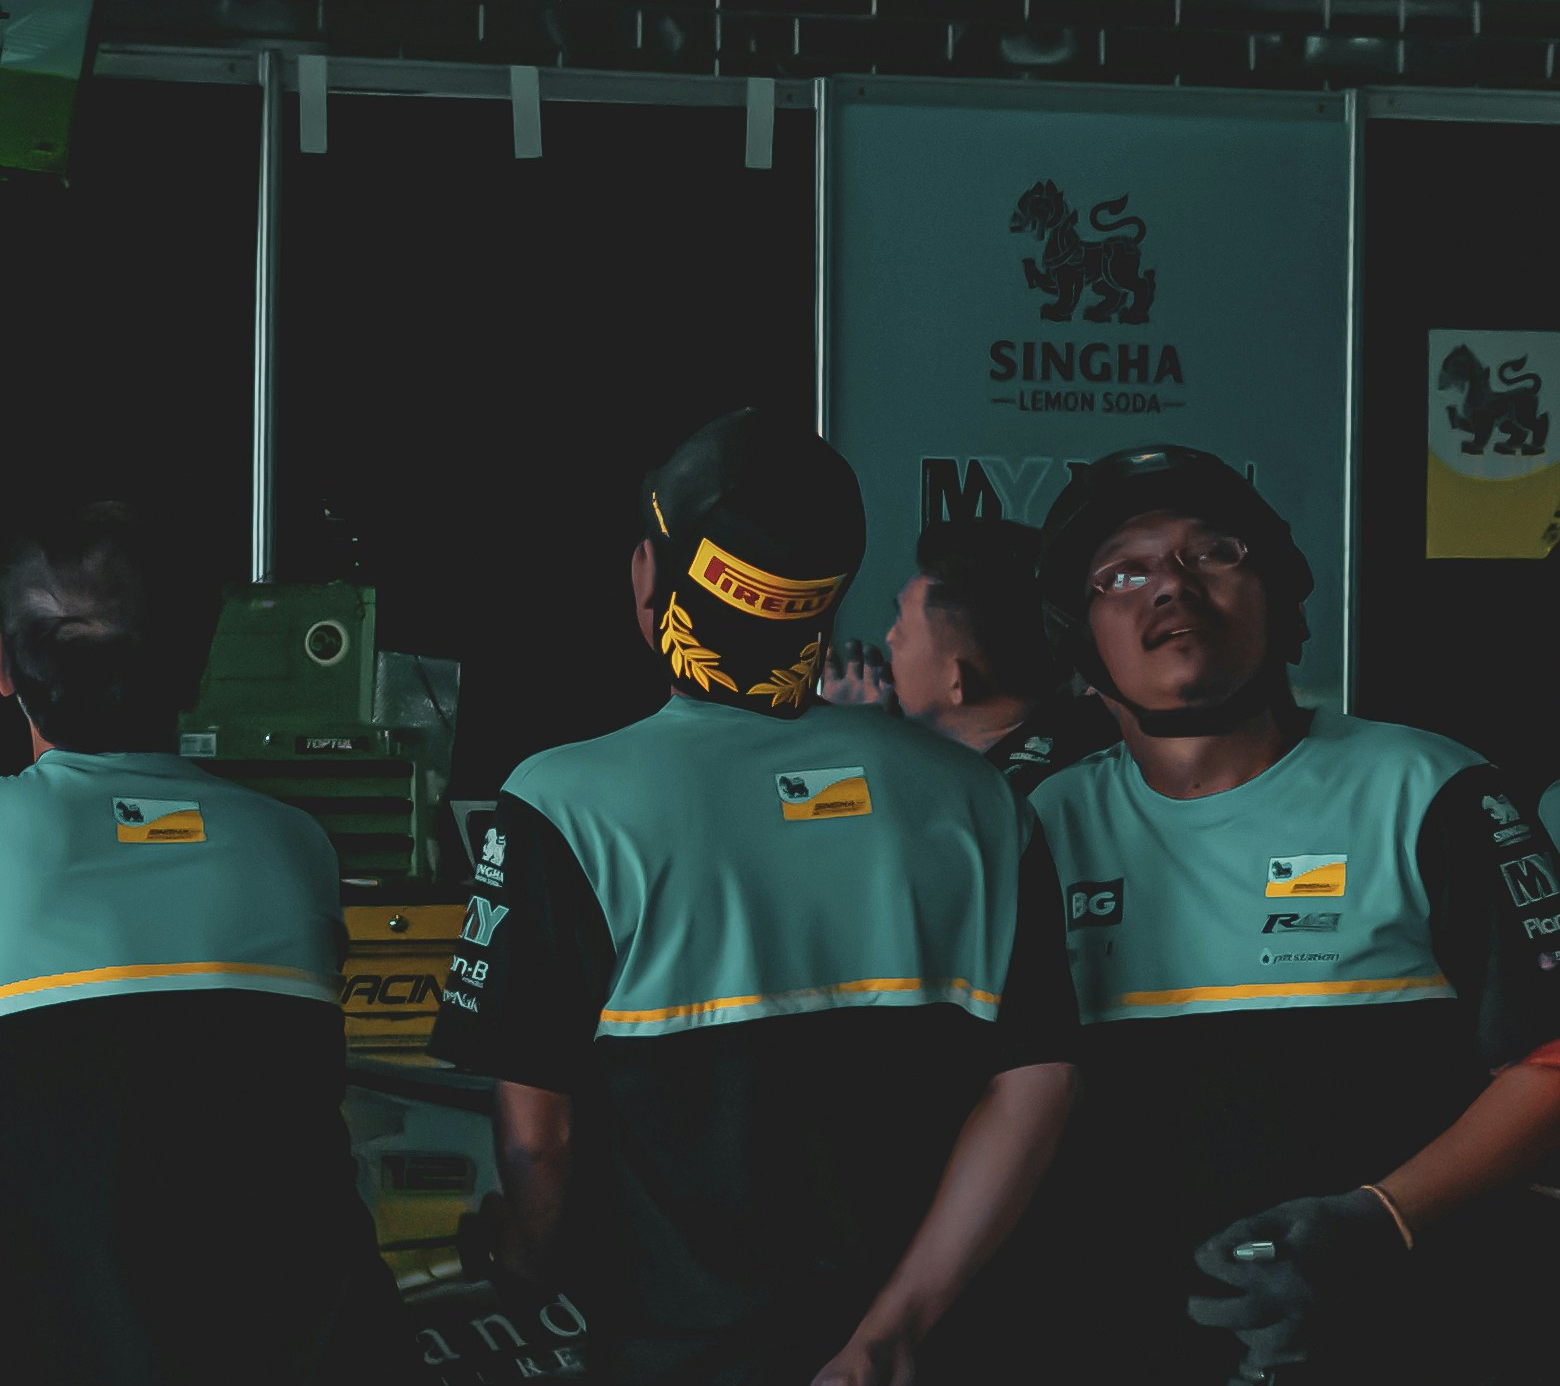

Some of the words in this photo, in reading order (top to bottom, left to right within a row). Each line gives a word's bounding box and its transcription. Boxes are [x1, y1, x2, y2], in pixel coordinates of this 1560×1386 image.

[989, 340, 1184, 385] SINGHA
[1019, 390, 1095, 413] LEMON
[1102, 392, 1161, 415] SODA
[1072, 891, 1116, 920] BG
